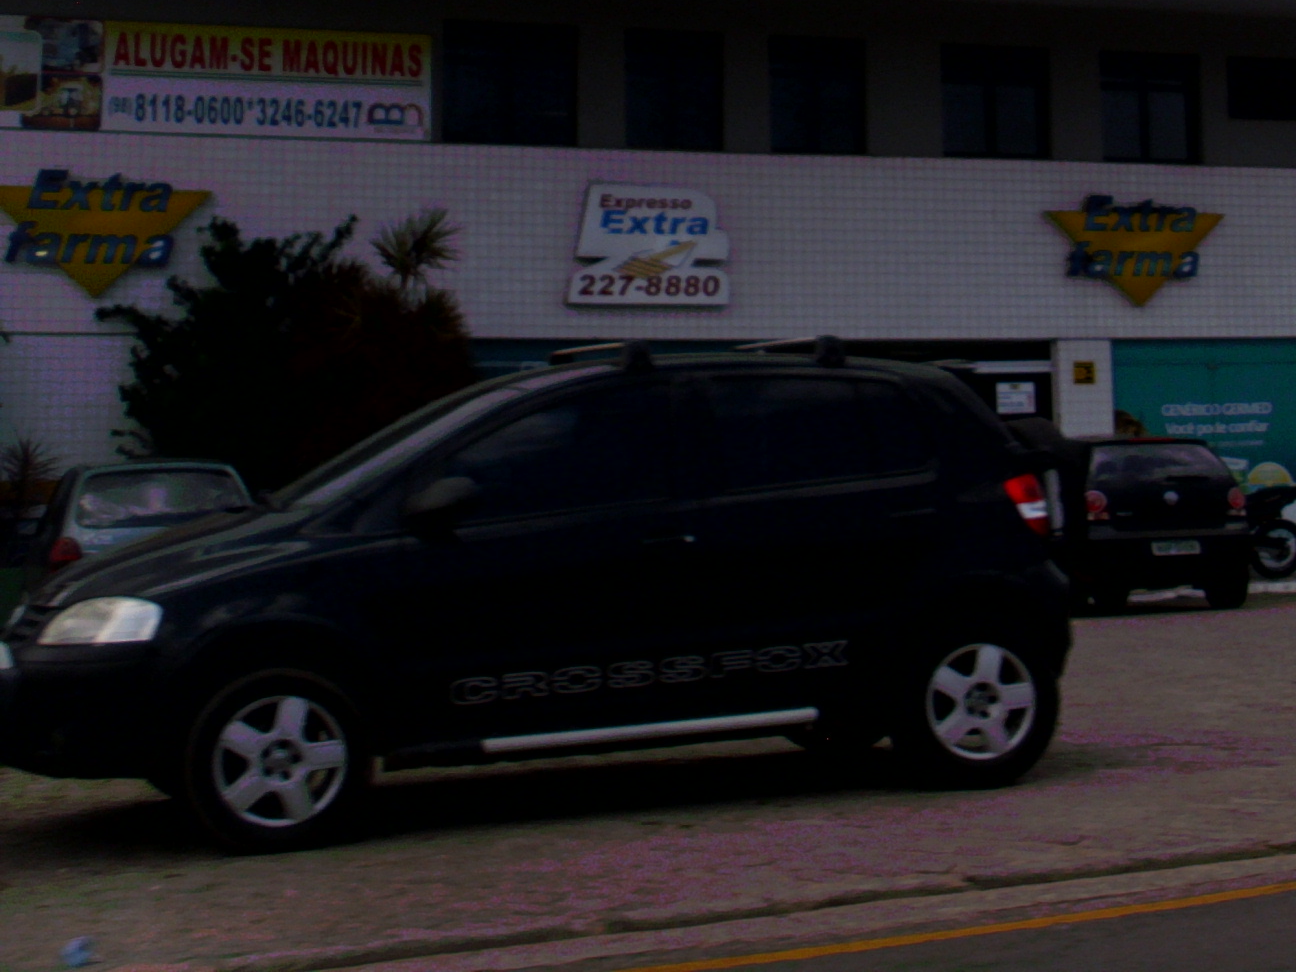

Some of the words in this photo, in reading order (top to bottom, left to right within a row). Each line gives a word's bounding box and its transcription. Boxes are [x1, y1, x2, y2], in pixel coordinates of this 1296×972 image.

[113, 31, 273, 72] ALUGAM-SE
[283, 39, 423, 77] MAQUINAS
[27, 168, 174, 213] Extra
[598, 193, 693, 211] Expresso
[600, 210, 709, 235] Extra
[1083, 194, 1198, 234] Extra
[4, 220, 175, 268] farma
[1066, 238, 1200, 280] farma
[578, 274, 721, 297] 227-8880
[448, 639, 850, 705] CROSSFOX
